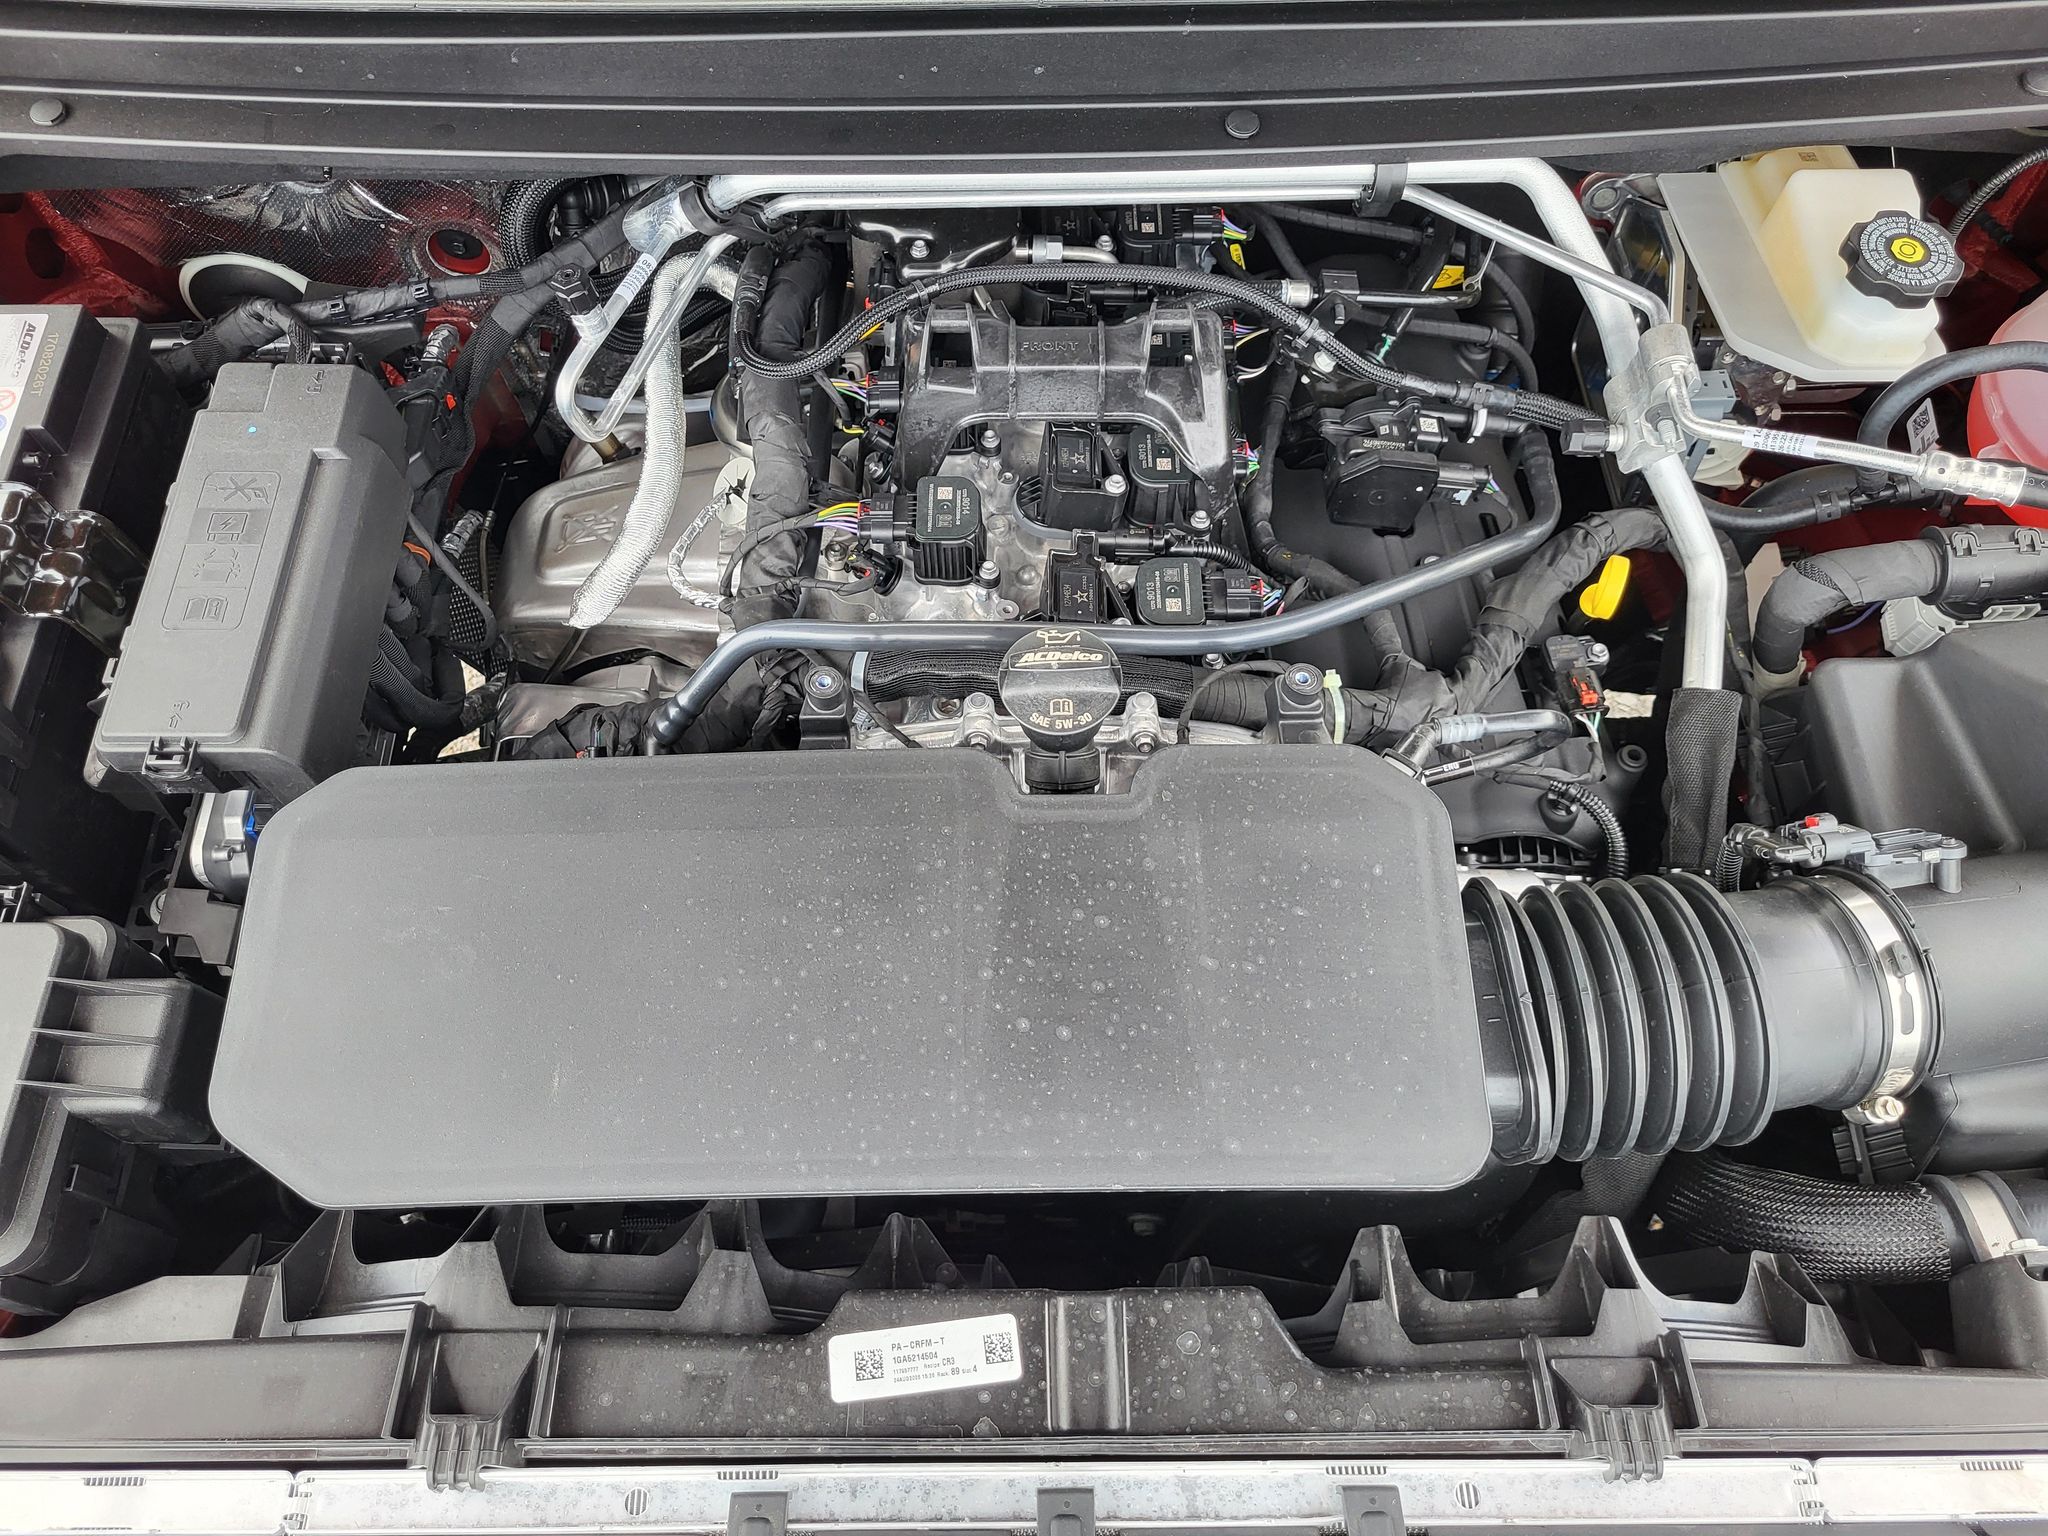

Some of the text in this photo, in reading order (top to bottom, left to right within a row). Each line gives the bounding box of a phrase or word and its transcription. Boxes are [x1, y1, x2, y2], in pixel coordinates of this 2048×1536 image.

[1020, 341, 1079, 351] FRONT
[1018, 650, 1103, 663] ACDelco
[1029, 712, 1093, 729] SAE 5W-30
[941, 1357, 956, 1367] CR3
[950, 1366, 960, 1376] 89
[972, 1364, 978, 1373] 4
